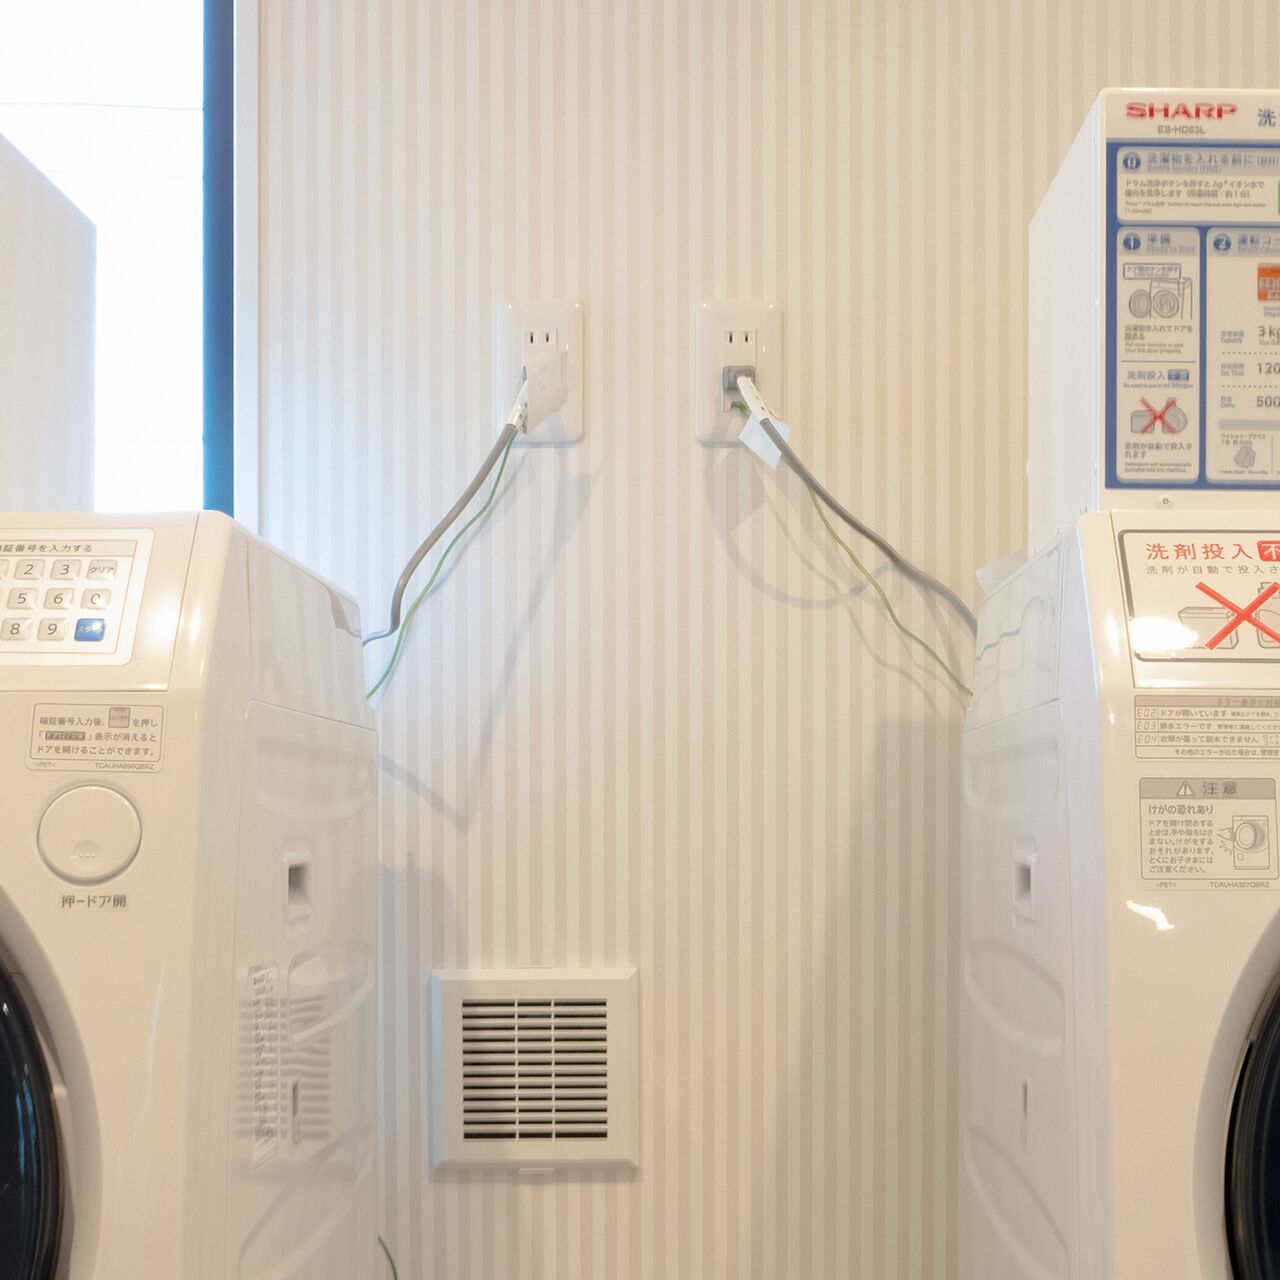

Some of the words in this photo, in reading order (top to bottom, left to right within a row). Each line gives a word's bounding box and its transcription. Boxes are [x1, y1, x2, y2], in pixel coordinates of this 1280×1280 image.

[1126, 102, 1237, 119] SHARP
[1145, 543, 1253, 560] 洗剤投入
[24, 564, 34, 575] 2
[60, 564, 69, 575] 3
[17, 593, 27, 604] 5
[53, 593, 63, 604] 6
[10, 623, 20, 635] 8
[48, 624, 57, 635] 9
[1202, 781, 1238, 796] 注意
[1148, 805, 1214, 815] けがの恐れあり
